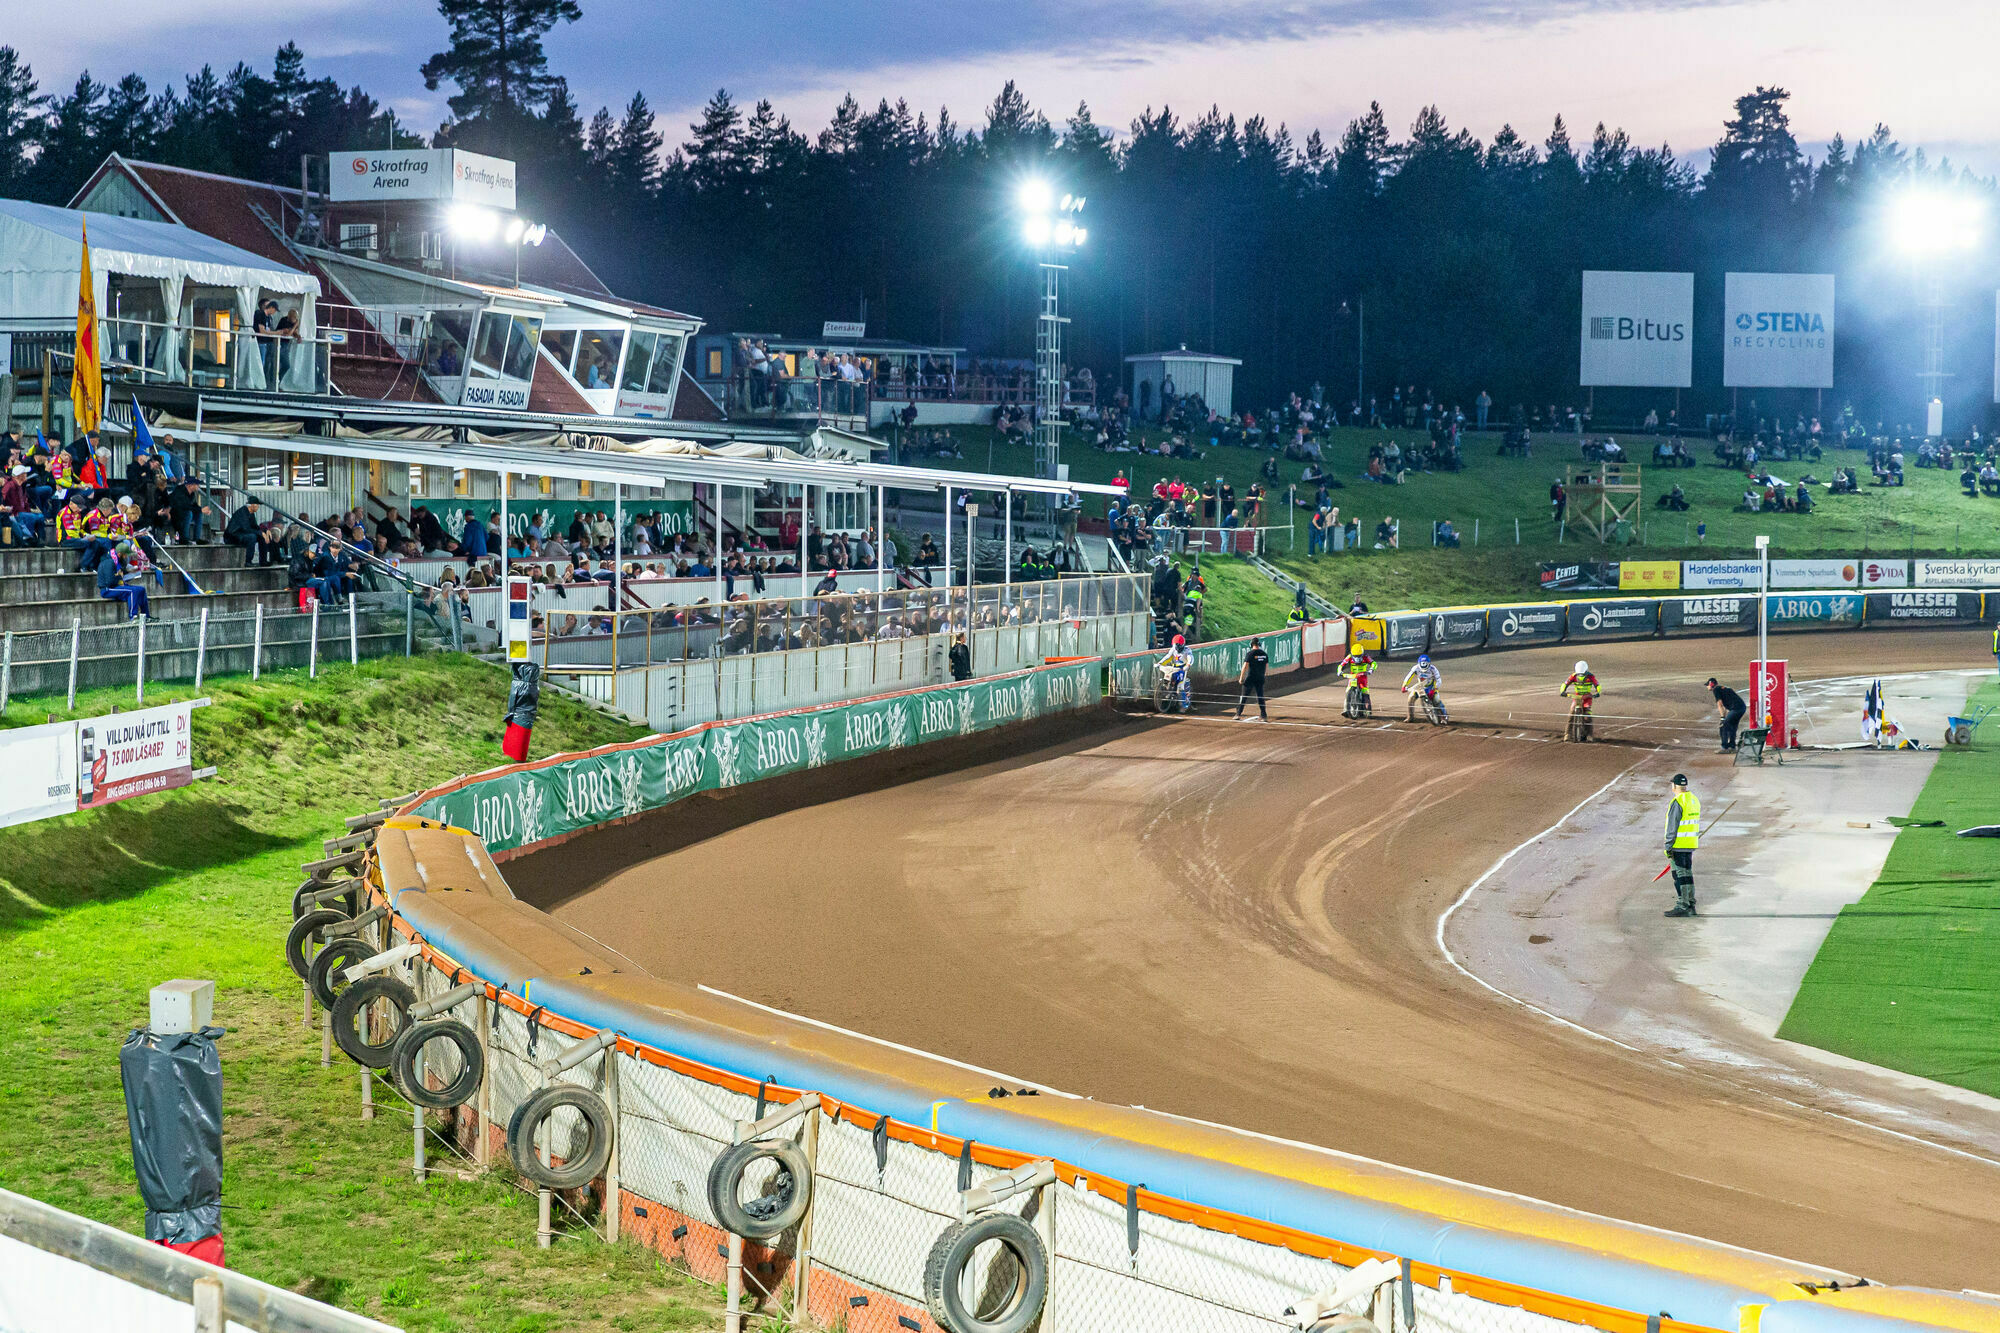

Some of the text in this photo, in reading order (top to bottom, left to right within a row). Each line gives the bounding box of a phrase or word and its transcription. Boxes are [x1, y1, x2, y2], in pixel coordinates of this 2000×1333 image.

[370, 158, 429, 174] Skrotfrag
[373, 177, 409, 189] Arena
[464, 166, 513, 189] Skrotfrag Arena
[1618, 318, 1685, 342] Bitus
[1756, 312, 1825, 333] STENA
[1733, 336, 1826, 349] RECYCLING
[466, 387, 495, 403] FASADIA
[497, 390, 526, 406] FASADIA
[1555, 565, 1580, 580] CENTER
[1689, 563, 1762, 575] Handelsbanken
[1880, 567, 1905, 578] VIDA
[1925, 563, 1966, 575] Svenska
[1707, 577, 1744, 587] Vimmerby
[1683, 600, 1740, 614] KAESER
[1774, 600, 1822, 618] ÅBRO
[1891, 594, 1957, 607] KAESER
[1683, 615, 1739, 625] KOMPRESSORER
[1891, 609, 1957, 617] KOMPRESSORER
[1275, 639, 1291, 663] ÅBRO
[1046, 675, 1073, 707] ÅBRO
[988, 685, 1017, 721] ÅBRO
[177, 715, 187, 731] DV
[920, 697, 954, 735] ÅBRO
[106, 718, 170, 746] VILL DU NÅ UT TILL
[844, 711, 883, 751] ÅBRO
[112, 741, 164, 766] 75 000 LÄSARE?
[176, 740, 187, 757] DH
[757, 726, 800, 770] ÅBRO
[665, 747, 706, 794] ÅBRO
[565, 768, 614, 821] ÅBRO
[472, 793, 515, 845] ÅBRO
